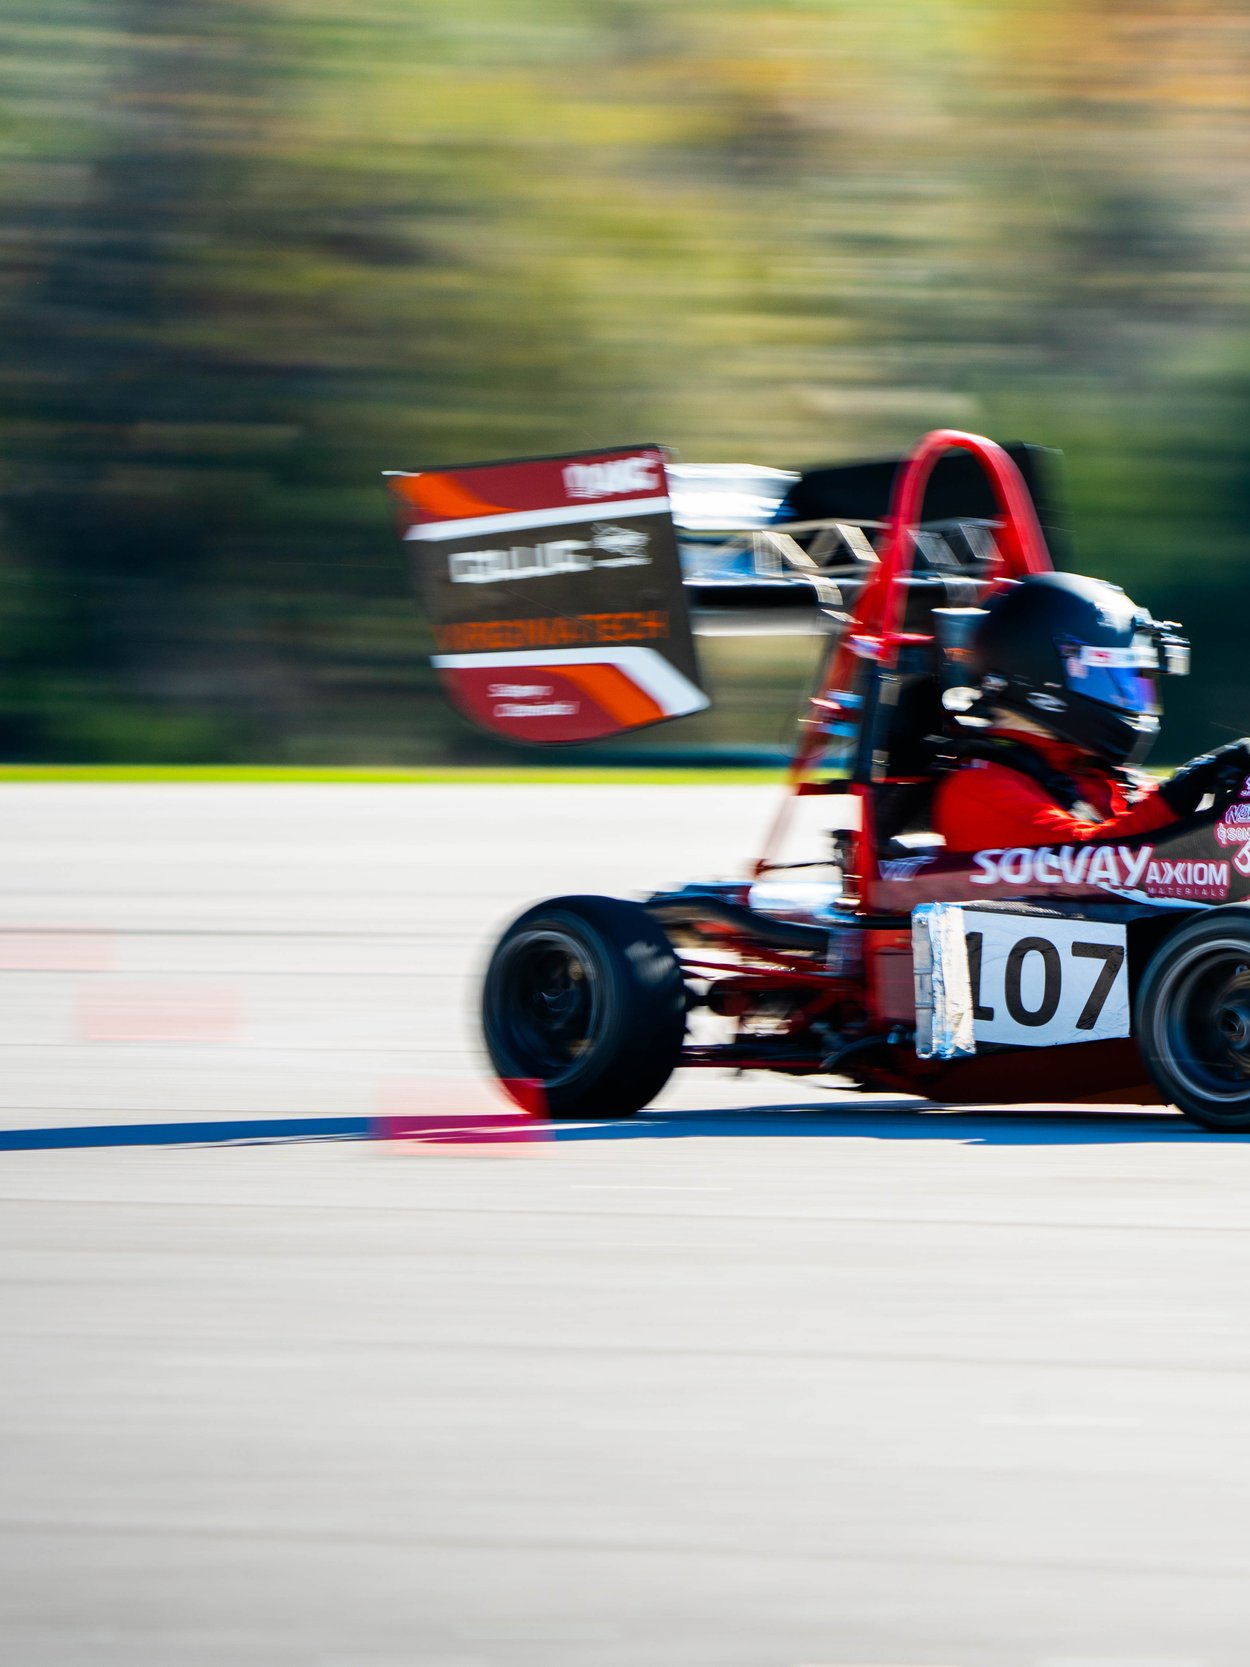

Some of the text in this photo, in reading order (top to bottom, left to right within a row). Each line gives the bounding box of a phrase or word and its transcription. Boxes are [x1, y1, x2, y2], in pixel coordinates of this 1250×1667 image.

[969, 845, 1153, 886] SOLVAY
[1145, 861, 1228, 886] AXIOM
[1147, 885, 1226, 897] MATERIALS
[965, 931, 1125, 1031] 107
